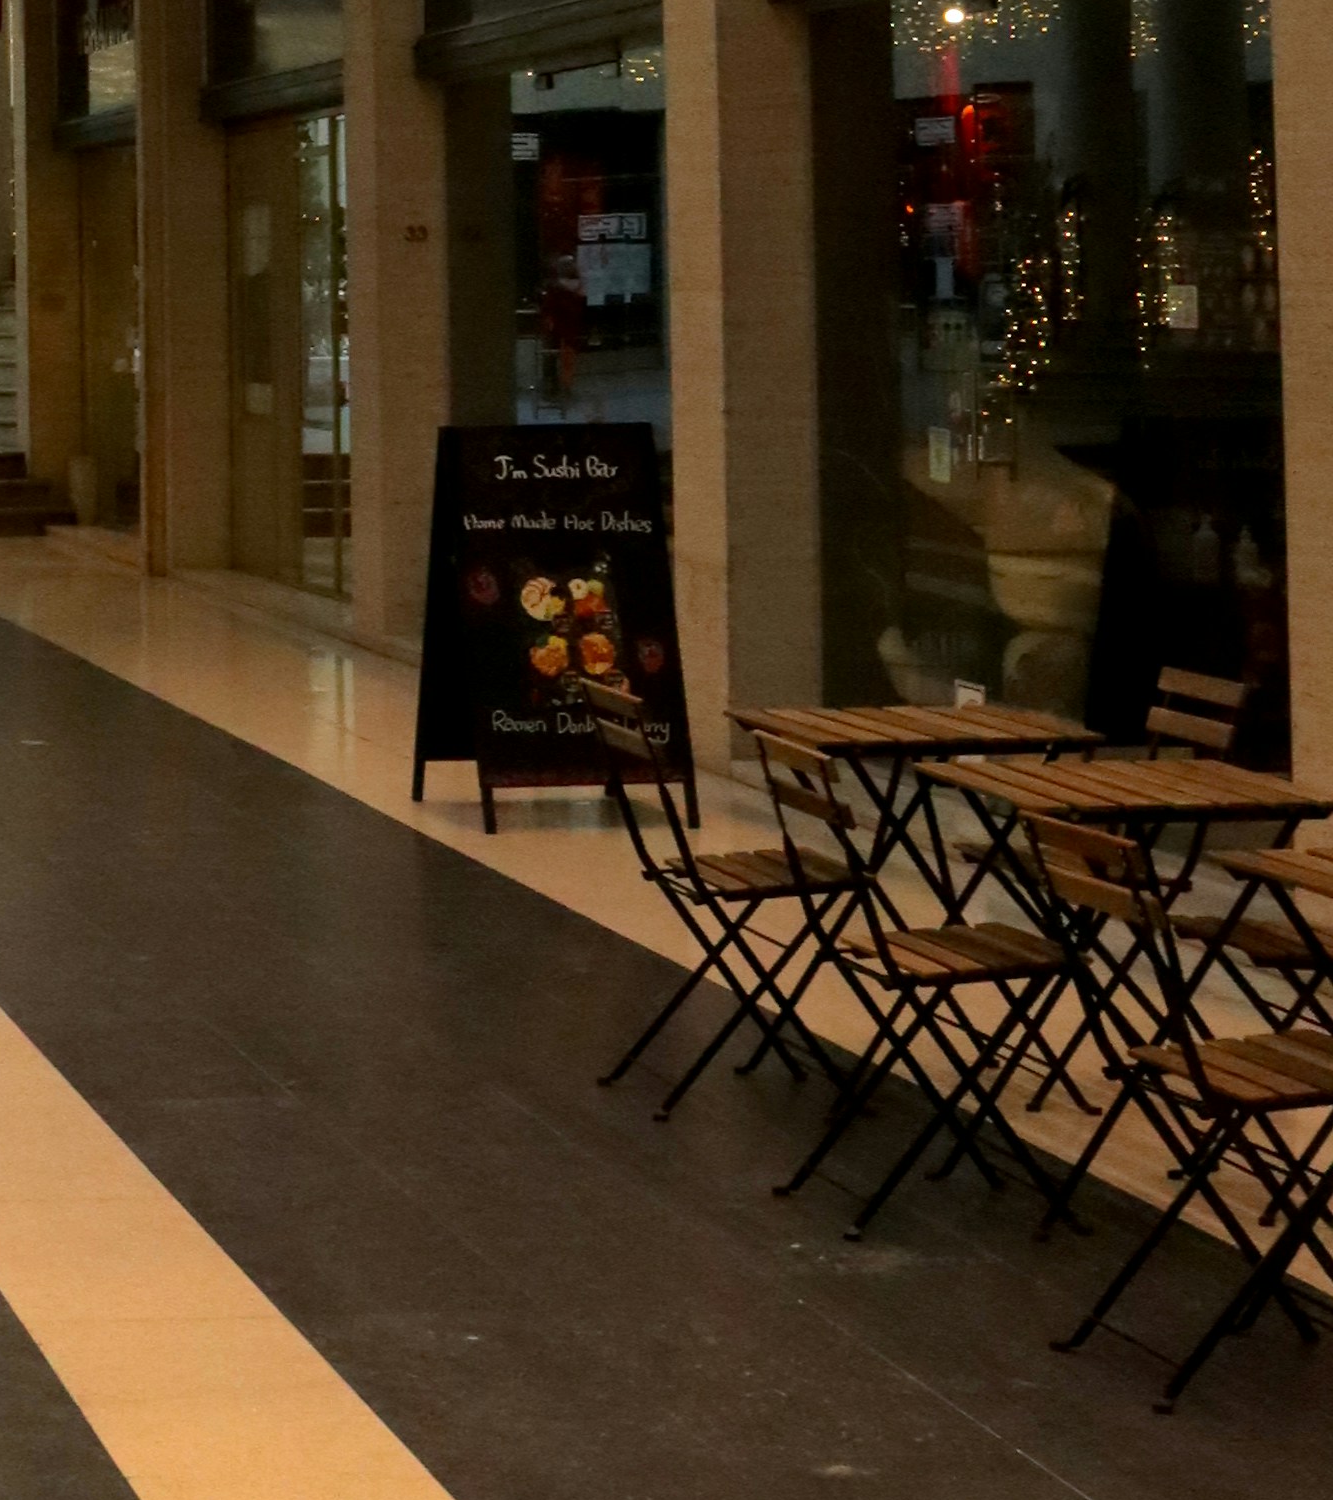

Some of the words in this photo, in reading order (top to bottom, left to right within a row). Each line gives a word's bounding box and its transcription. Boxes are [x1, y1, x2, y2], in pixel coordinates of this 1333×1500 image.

[533, 454, 581, 479] Sushi
[586, 455, 619, 479] Bar
[463, 513, 505, 531] Home
[511, 511, 557, 531] Made
[563, 513, 594, 532] Hot
[601, 510, 653, 534] Dishes
[492, 709, 547, 733] Ramen
